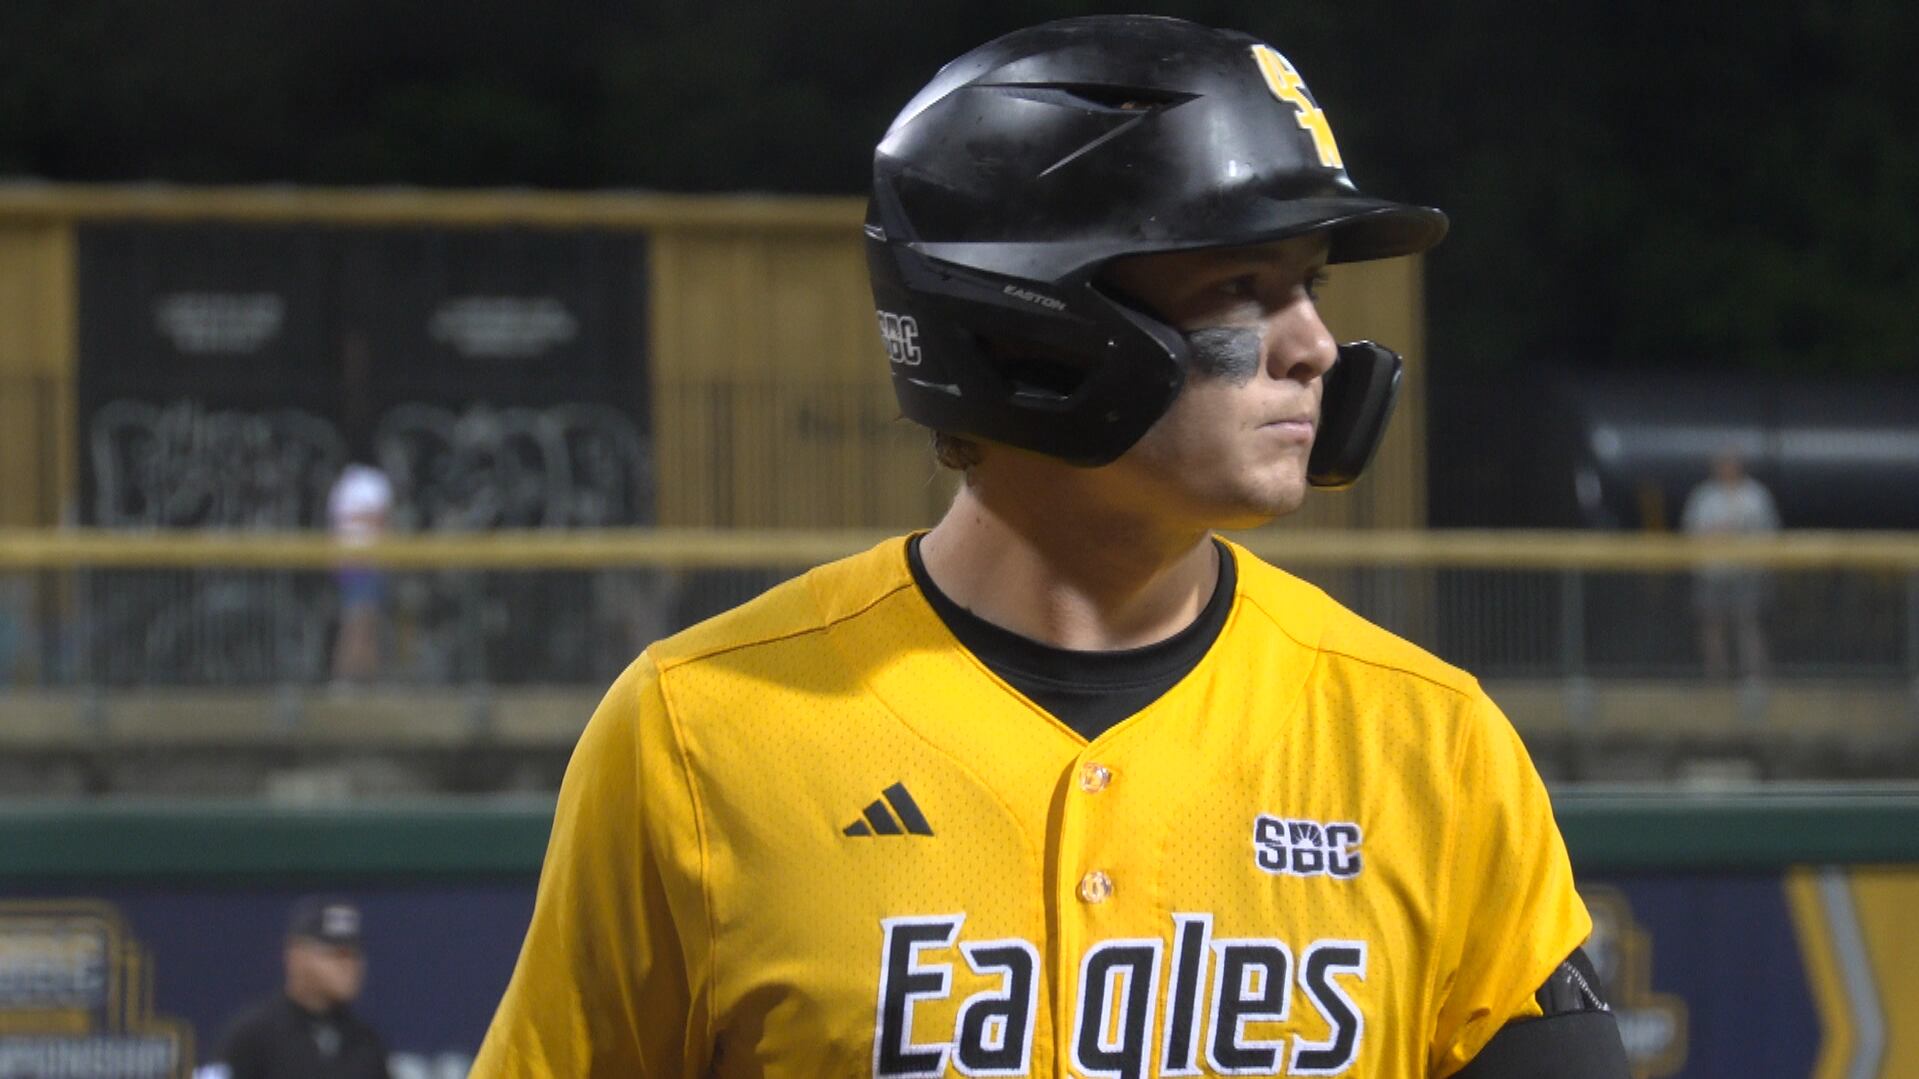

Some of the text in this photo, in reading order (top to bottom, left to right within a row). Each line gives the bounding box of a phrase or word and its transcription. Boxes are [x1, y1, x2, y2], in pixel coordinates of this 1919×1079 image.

[1003, 284, 1066, 311] EASTON
[1253, 813, 1363, 880] SBC
[874, 911, 1367, 1079] Eagles
